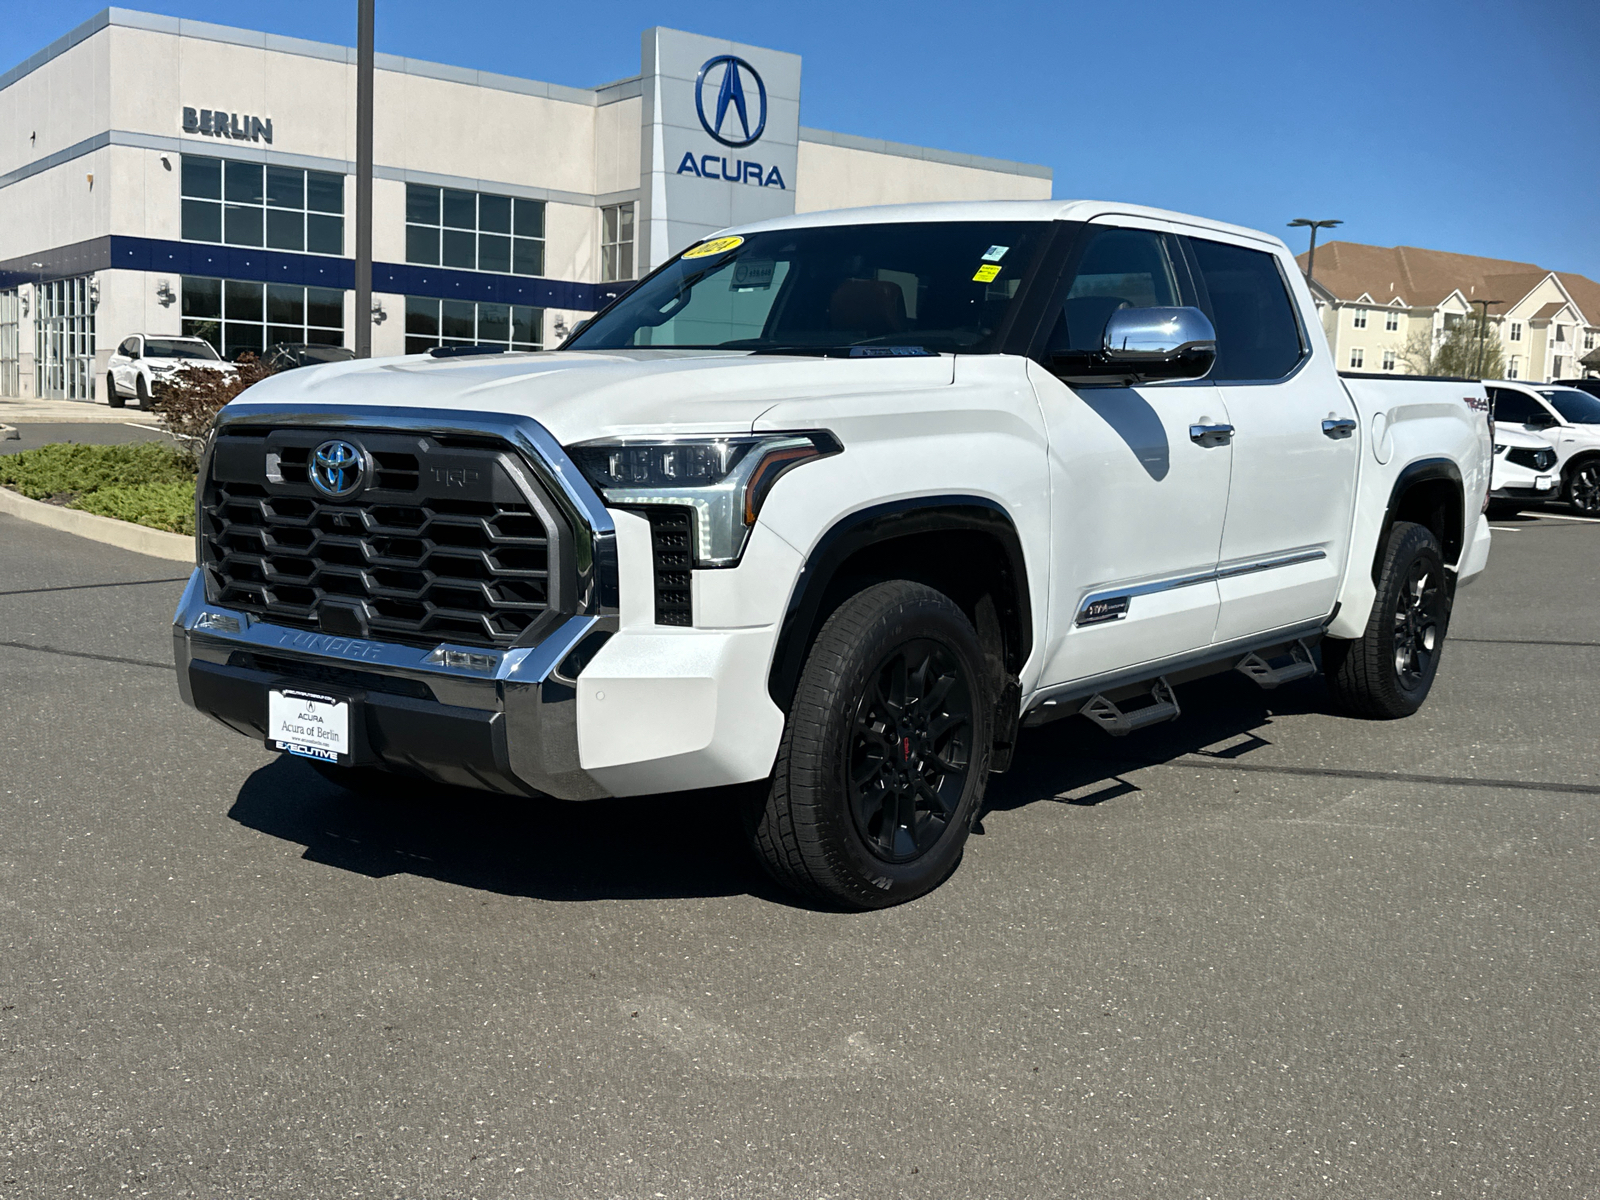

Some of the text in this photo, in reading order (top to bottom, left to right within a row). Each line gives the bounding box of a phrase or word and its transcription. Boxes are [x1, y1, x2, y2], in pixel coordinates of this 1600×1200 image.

[182, 106, 273, 144] BERLIN
[676, 151, 785, 190] ACURA
[430, 465, 480, 488] TRD
[278, 629, 385, 659] TUNDRA
[297, 712, 325, 724] ACURA
[281, 720, 340, 742] Acura of Berlin
[275, 740, 339, 761] EXECUTIVE
